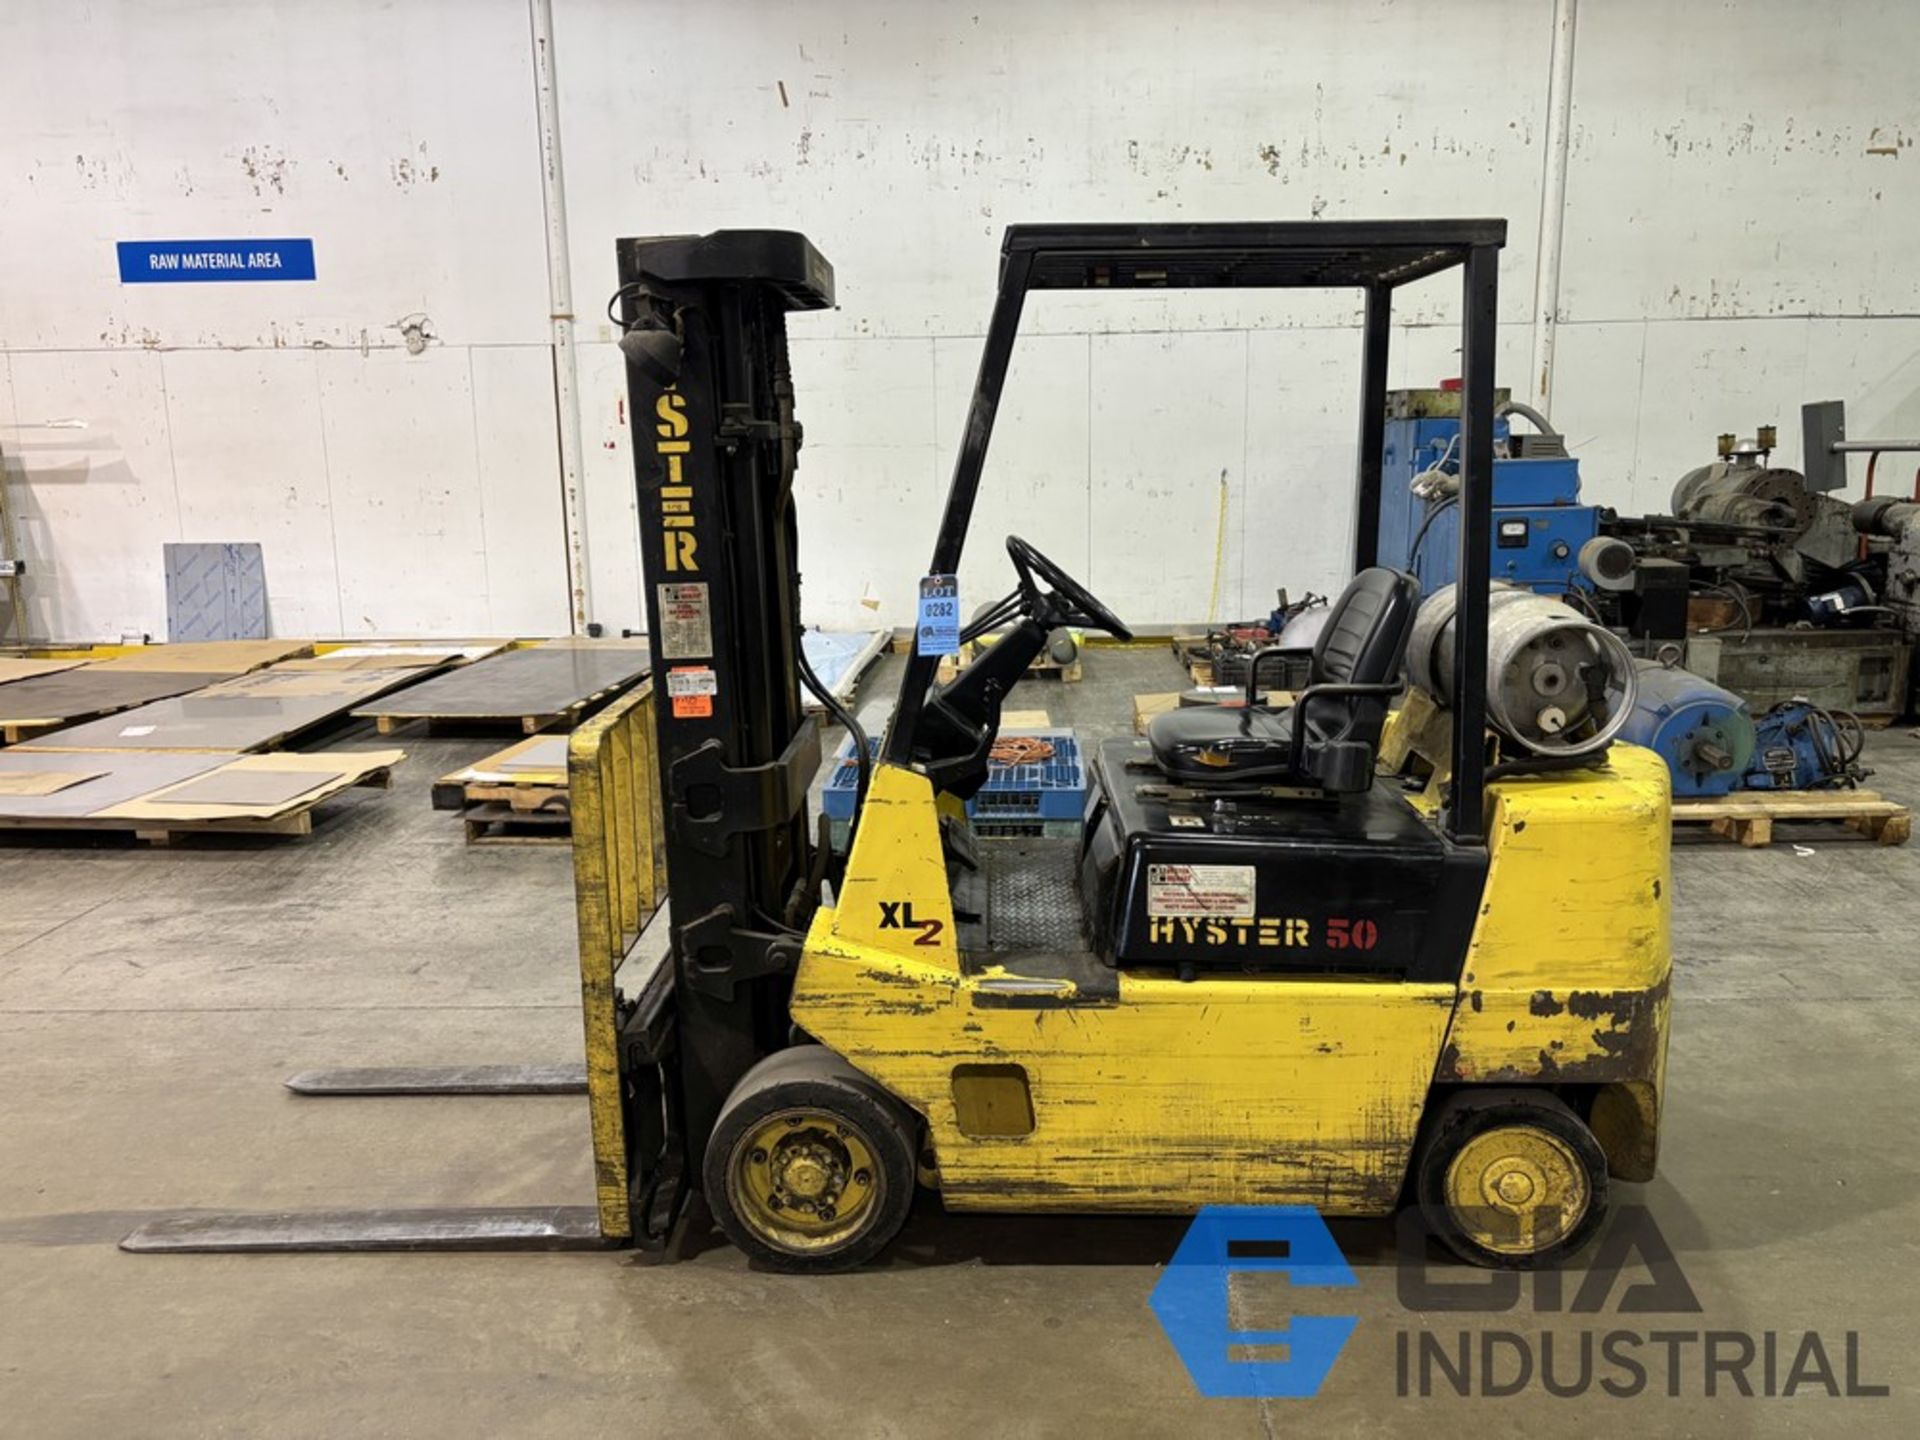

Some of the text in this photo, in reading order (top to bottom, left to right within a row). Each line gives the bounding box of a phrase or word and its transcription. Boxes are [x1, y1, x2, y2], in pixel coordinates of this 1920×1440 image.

[150, 253, 282, 269] RAW MATERIAL AREA
[923, 586, 954, 598] LOT
[925, 602, 953, 617] 0282
[1150, 917, 1377, 949] HYSTER 50
